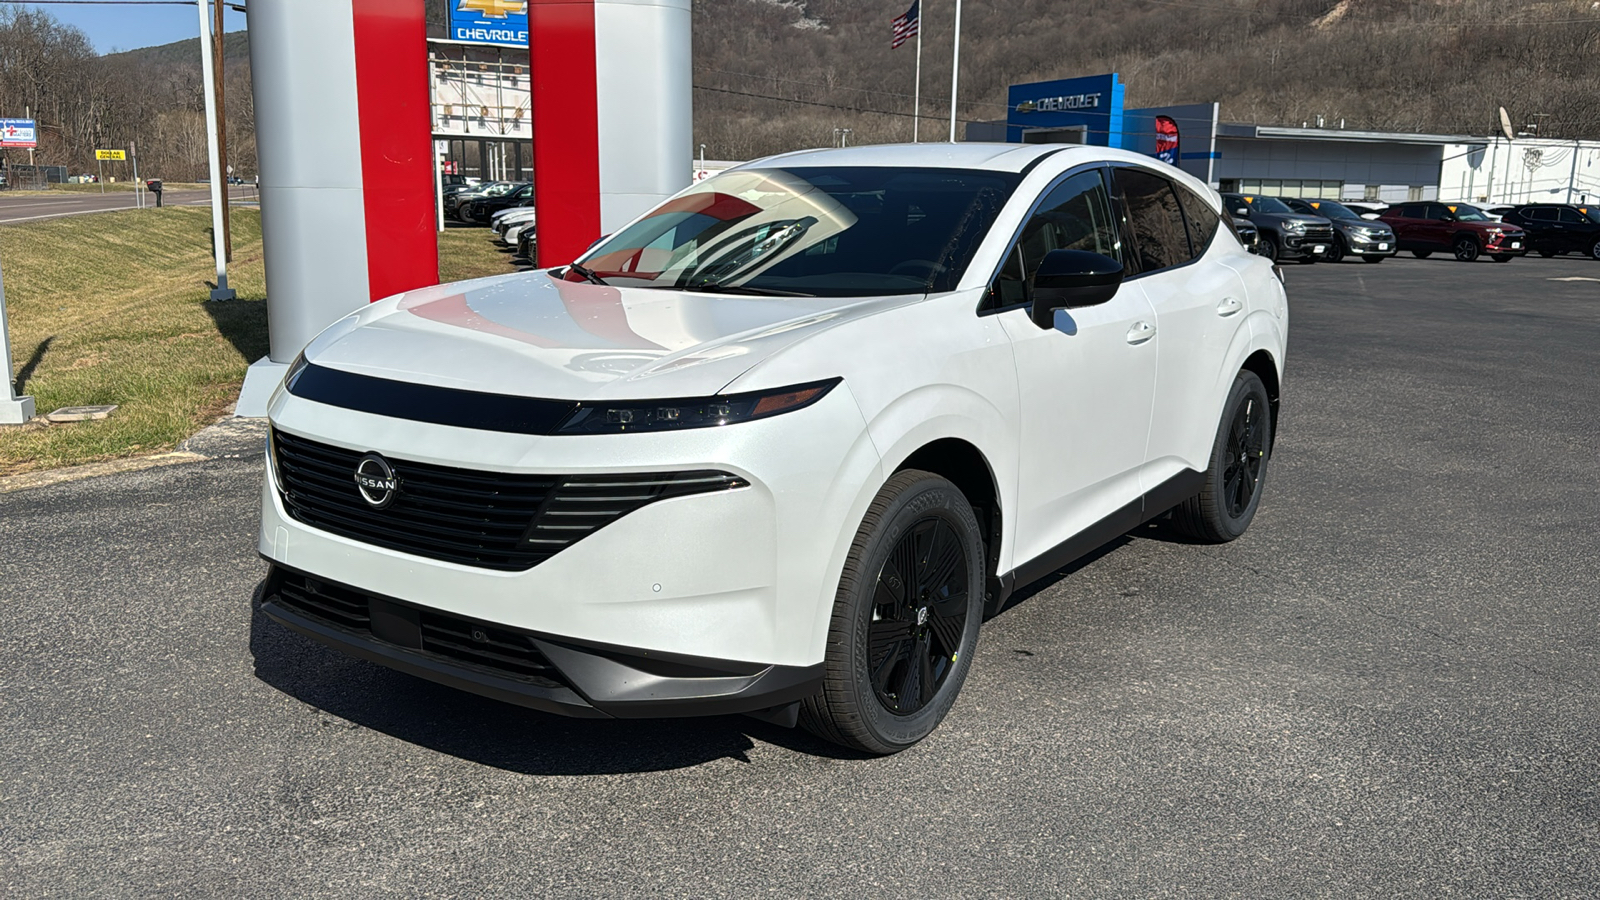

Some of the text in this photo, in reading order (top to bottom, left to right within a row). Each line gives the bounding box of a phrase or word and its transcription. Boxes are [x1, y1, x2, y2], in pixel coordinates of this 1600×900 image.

[457, 27, 529, 42] CHEVROLE
[1037, 92, 1101, 112] CHEVROLET
[355, 476, 395, 489] NISSAN
